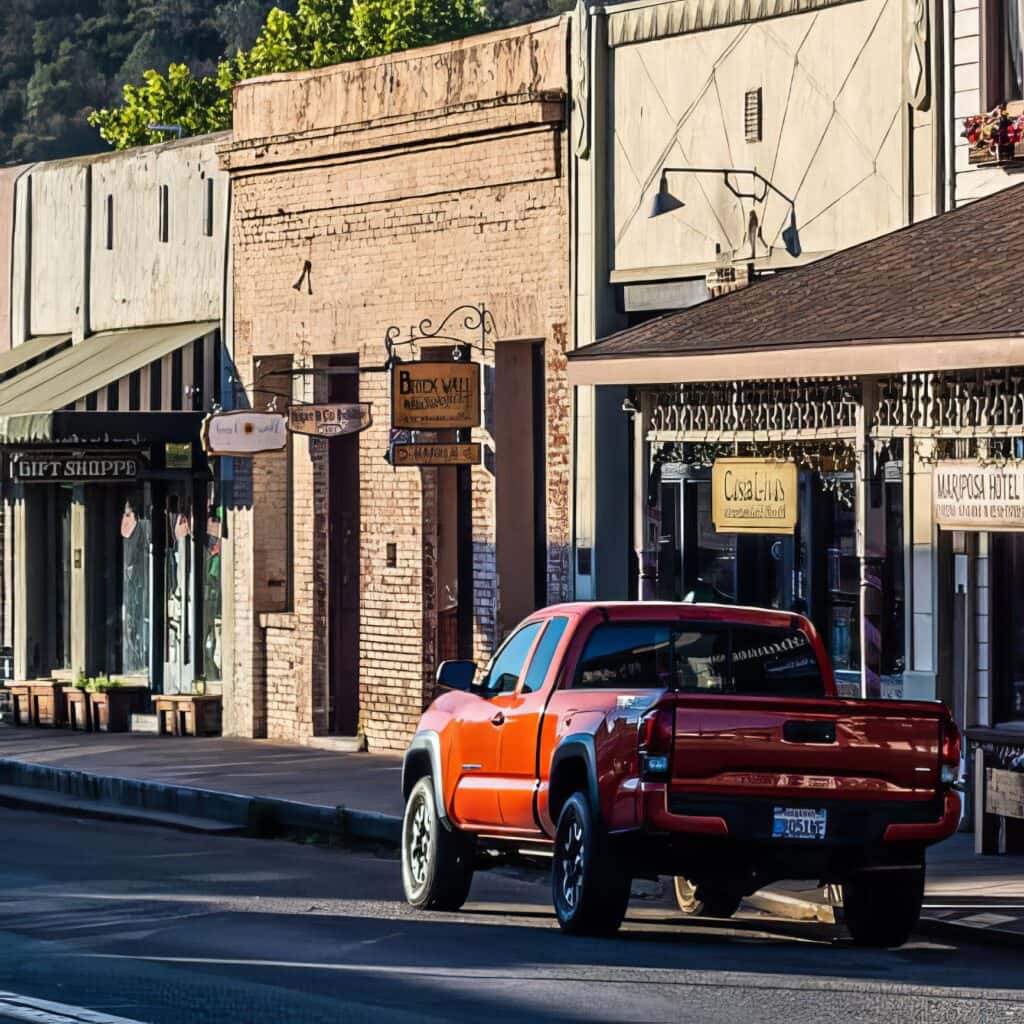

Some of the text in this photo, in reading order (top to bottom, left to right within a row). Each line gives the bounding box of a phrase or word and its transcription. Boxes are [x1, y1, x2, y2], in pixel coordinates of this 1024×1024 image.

[19, 461, 61, 477] GIFT
[937, 473, 985, 502] MARIPOSA
[989, 473, 1020, 500] HOTEL
